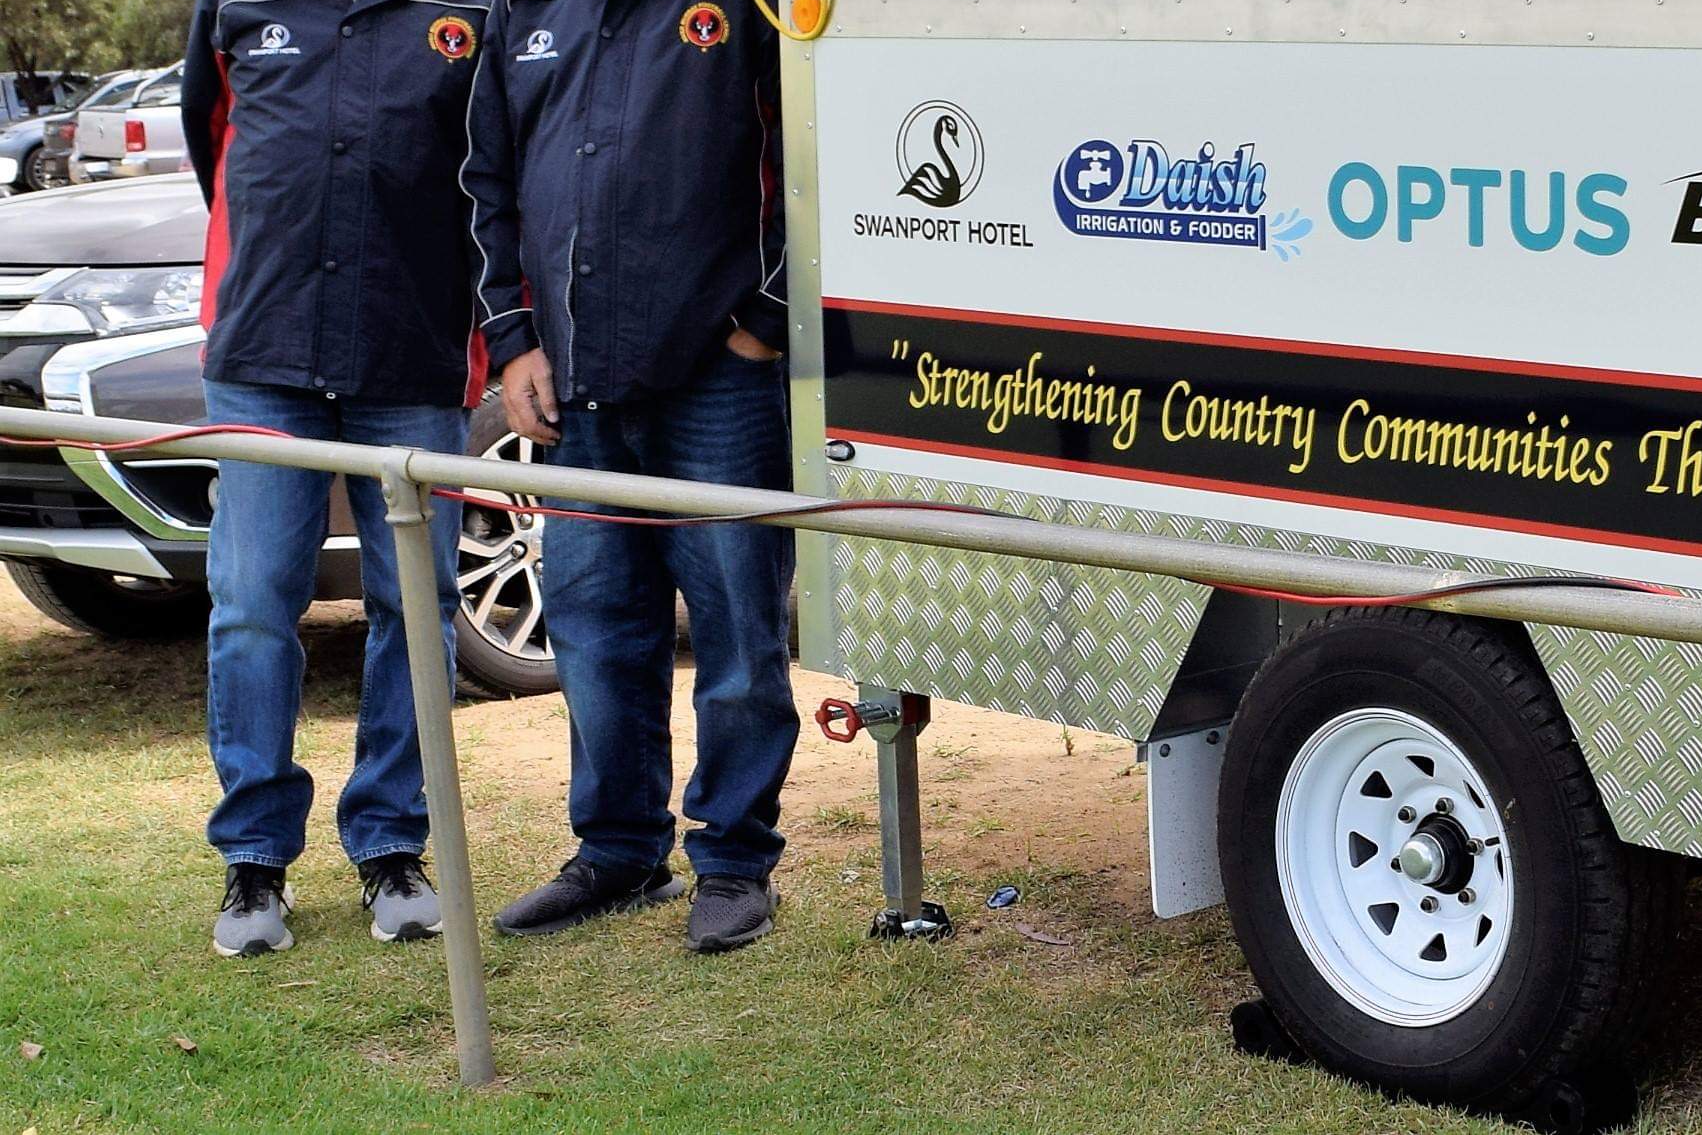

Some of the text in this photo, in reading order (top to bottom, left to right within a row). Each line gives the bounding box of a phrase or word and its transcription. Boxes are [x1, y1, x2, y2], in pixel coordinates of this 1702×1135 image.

[1120, 139, 1266, 214] Daish
[1327, 162, 1630, 256] OPTUS
[854, 214, 1034, 247] SWANPORT HOTEL
[1076, 215, 1256, 241] IRRIGATION & FODDER
[891, 339, 1143, 451] "Strengthening
[1161, 380, 1316, 474] Country
[1337, 398, 1614, 486] Communities
